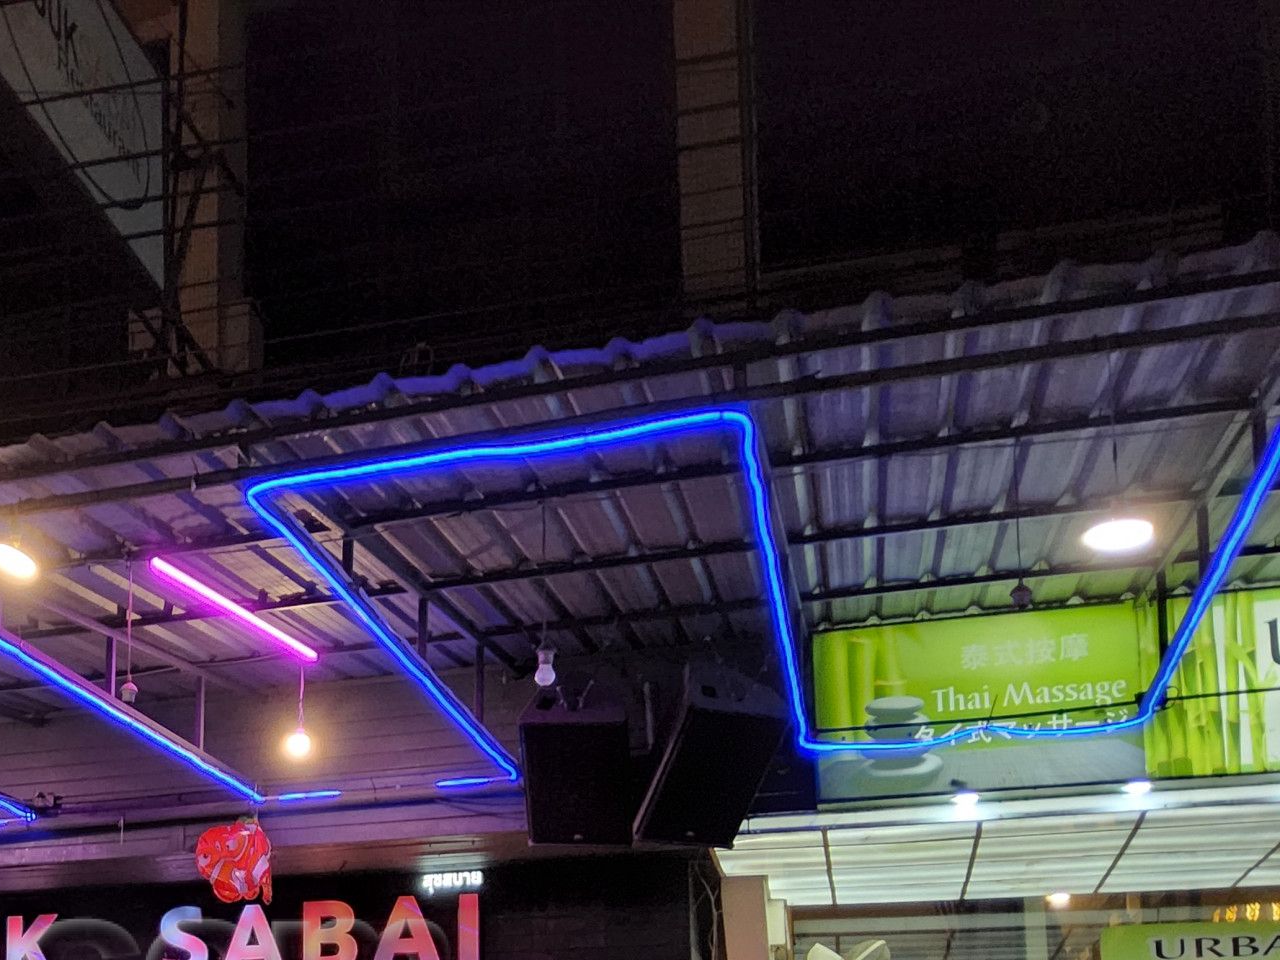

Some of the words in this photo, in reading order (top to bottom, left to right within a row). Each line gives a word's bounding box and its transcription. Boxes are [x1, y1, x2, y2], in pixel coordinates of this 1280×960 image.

[961, 633, 1090, 670] 泰式按摩
[931, 685, 992, 713] Thai
[1003, 679, 1128, 707] Massage
